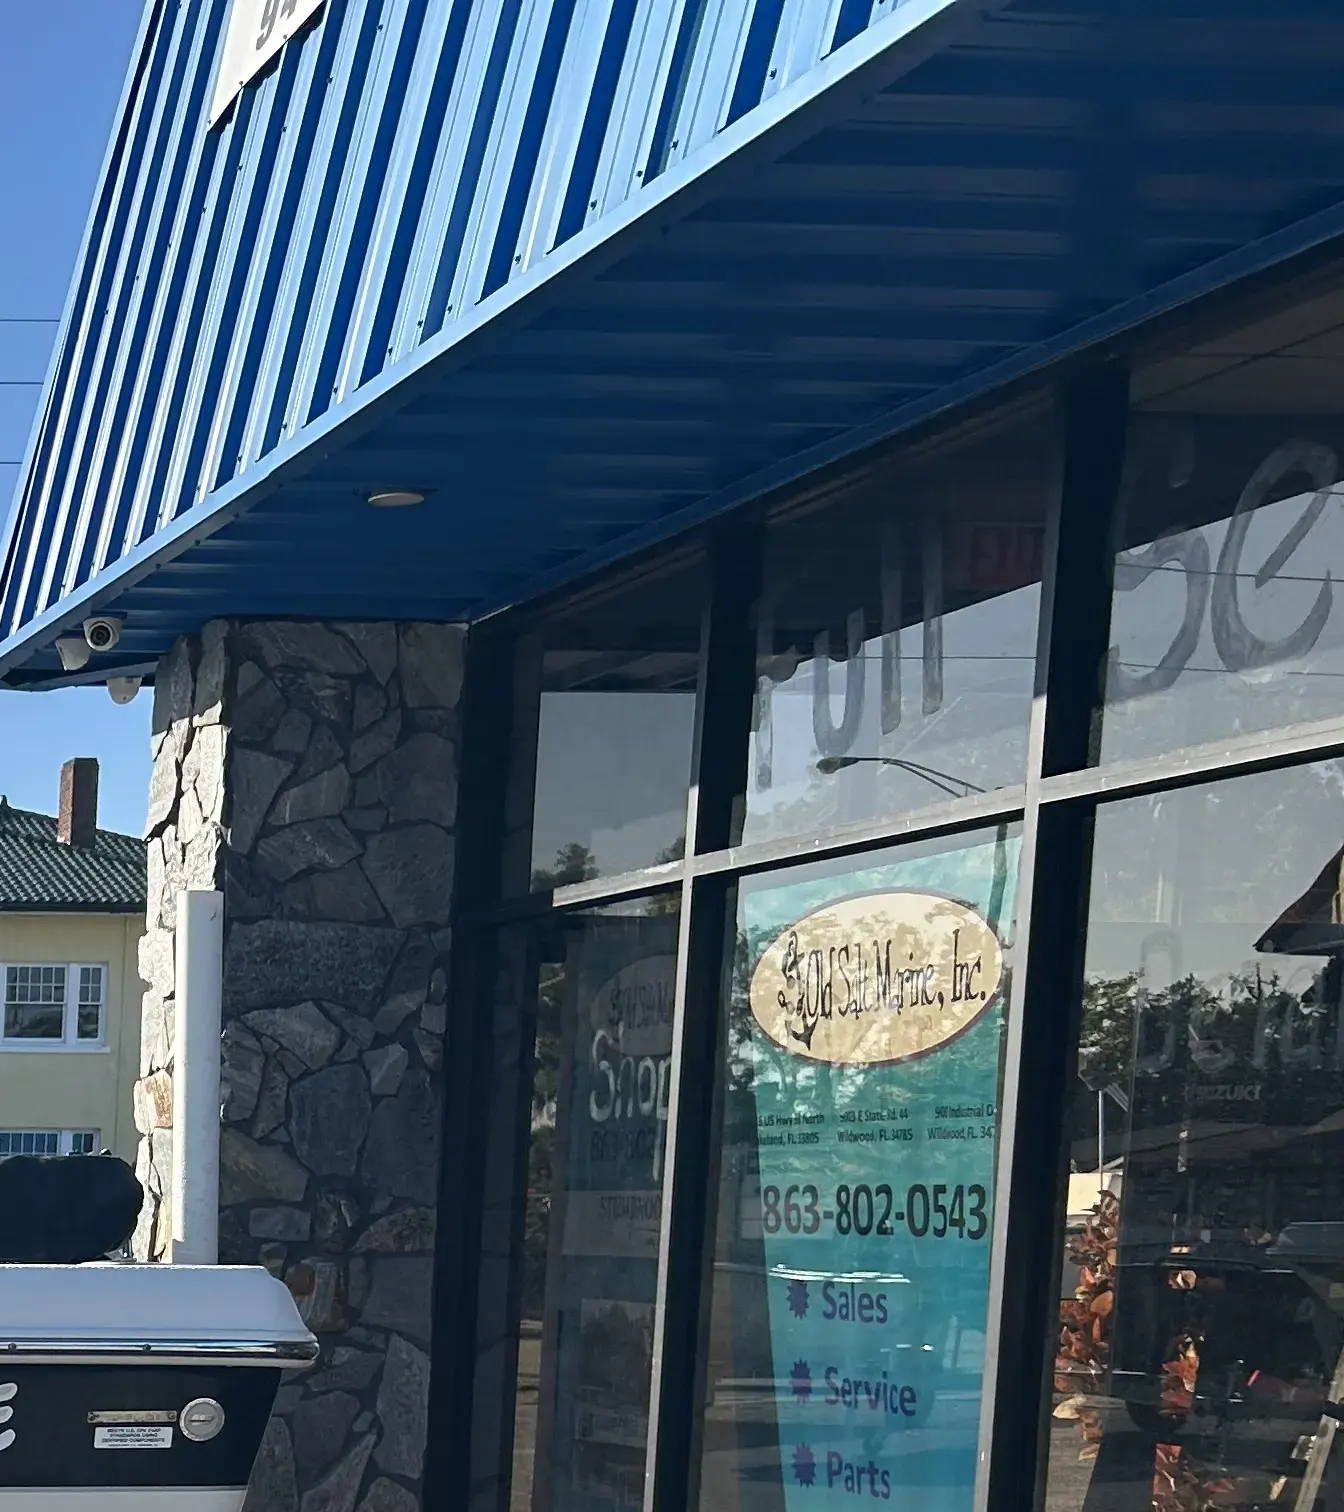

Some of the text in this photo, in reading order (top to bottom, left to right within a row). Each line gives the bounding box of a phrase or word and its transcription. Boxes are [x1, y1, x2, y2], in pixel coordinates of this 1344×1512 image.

[804, 928, 986, 1021] Old Salt Marine, Inc.
[763, 1183, 988, 1241] 863-802-0543
[822, 1280, 888, 1324] Sales
[824, 1366, 917, 1417] Service
[827, 1451, 891, 1500] Parts
